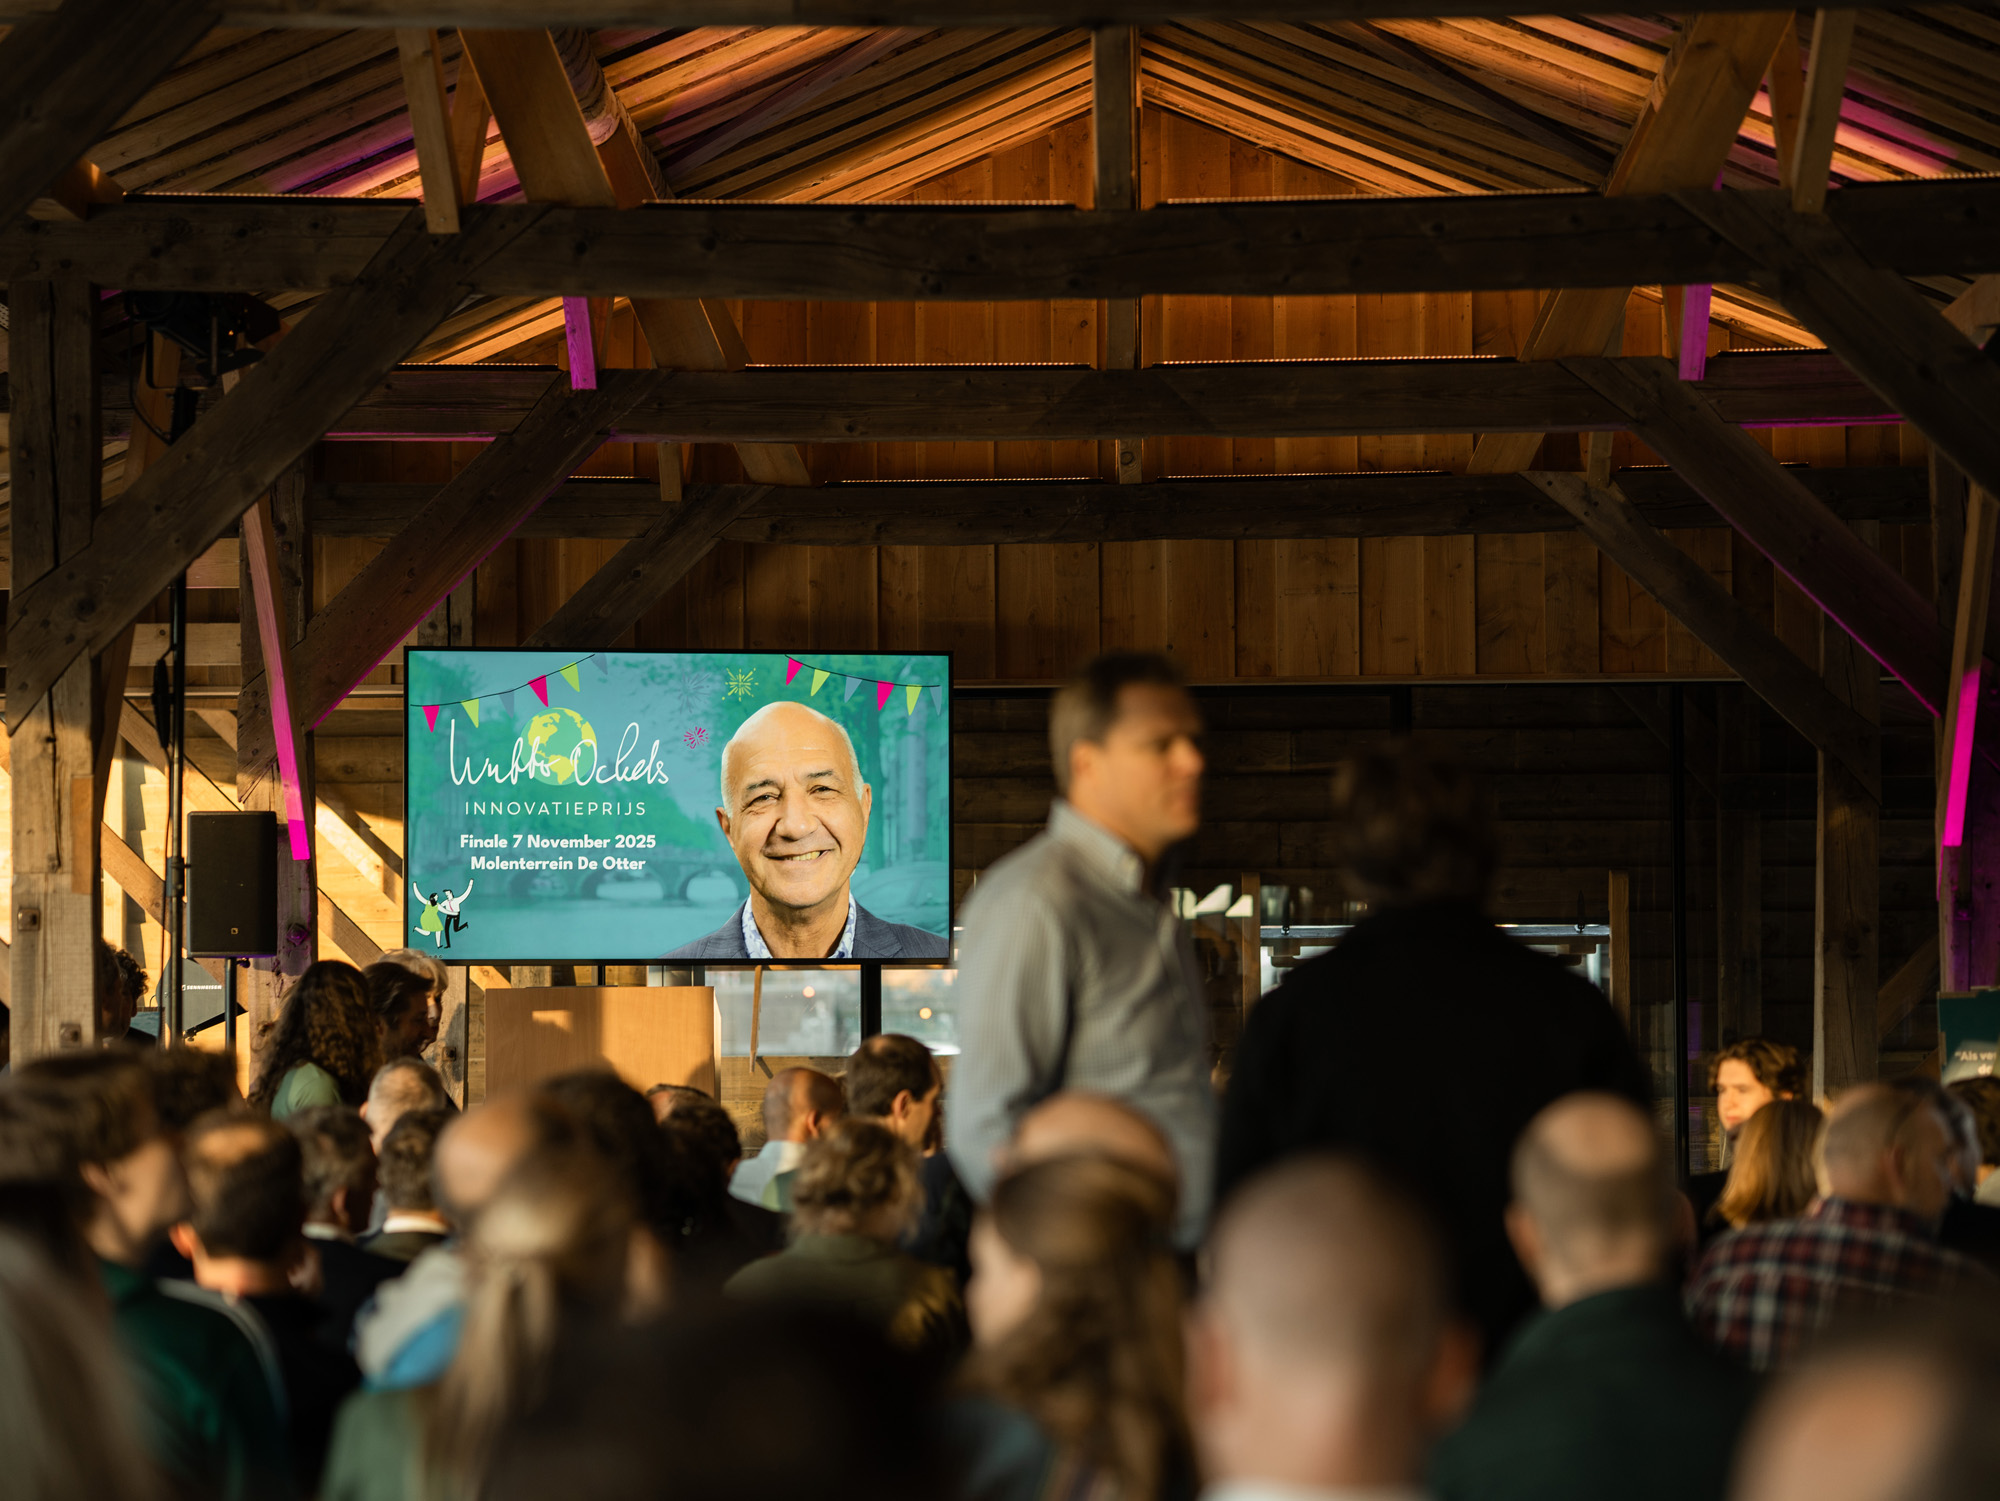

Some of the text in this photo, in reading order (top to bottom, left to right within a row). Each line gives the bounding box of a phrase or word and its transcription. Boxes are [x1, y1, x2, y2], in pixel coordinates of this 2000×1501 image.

[450, 718, 669, 786] Wubbo Ockels
[465, 801, 646, 816] INNOVATIEPRIJS
[460, 834, 656, 848] Finale 7 November 2025
[470, 856, 646, 870] Molenterrein De Otter
